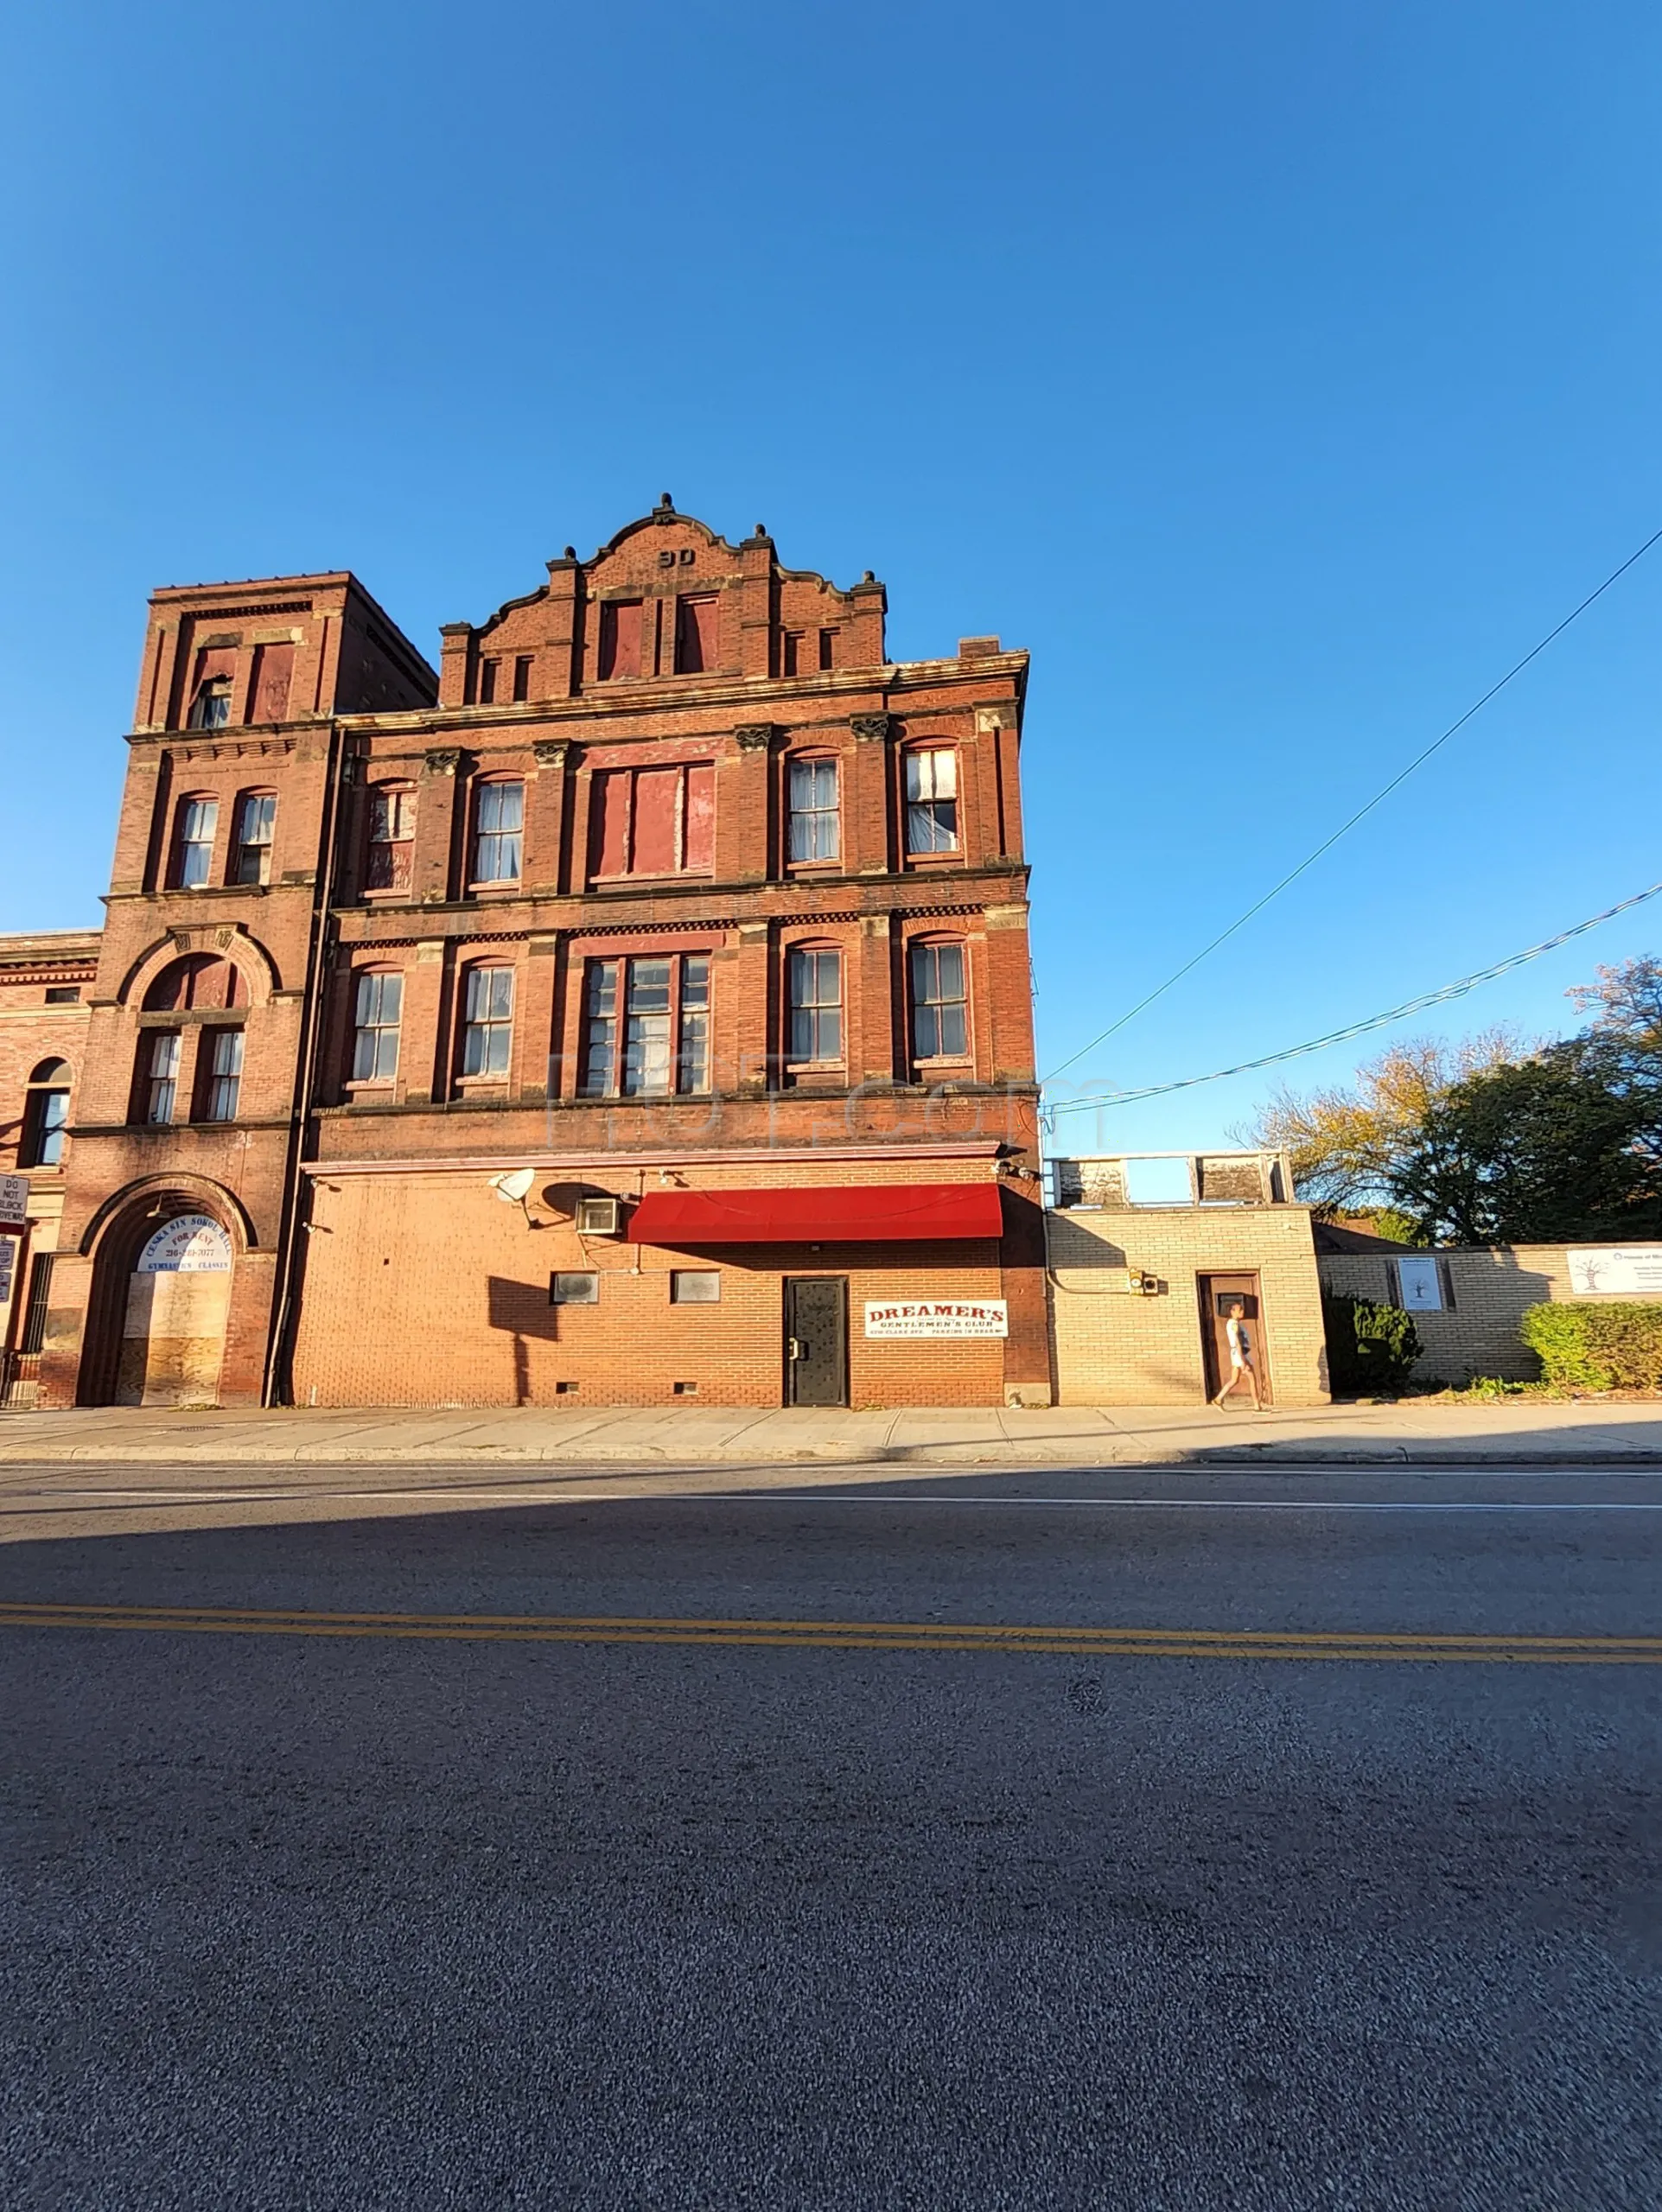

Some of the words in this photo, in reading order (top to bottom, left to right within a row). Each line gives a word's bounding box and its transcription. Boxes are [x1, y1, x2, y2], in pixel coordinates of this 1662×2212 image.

[6, 1179, 18, 1189] DO
[3, 1189, 20, 1199] NOT
[191, 1217, 218, 1232] SOKOL
[171, 1232, 188, 1246] FOR
[190, 1230, 214, 1246] RENT
[198, 1262, 229, 1270] CLASSES
[869, 1304, 1004, 1323] DREAMER'S
